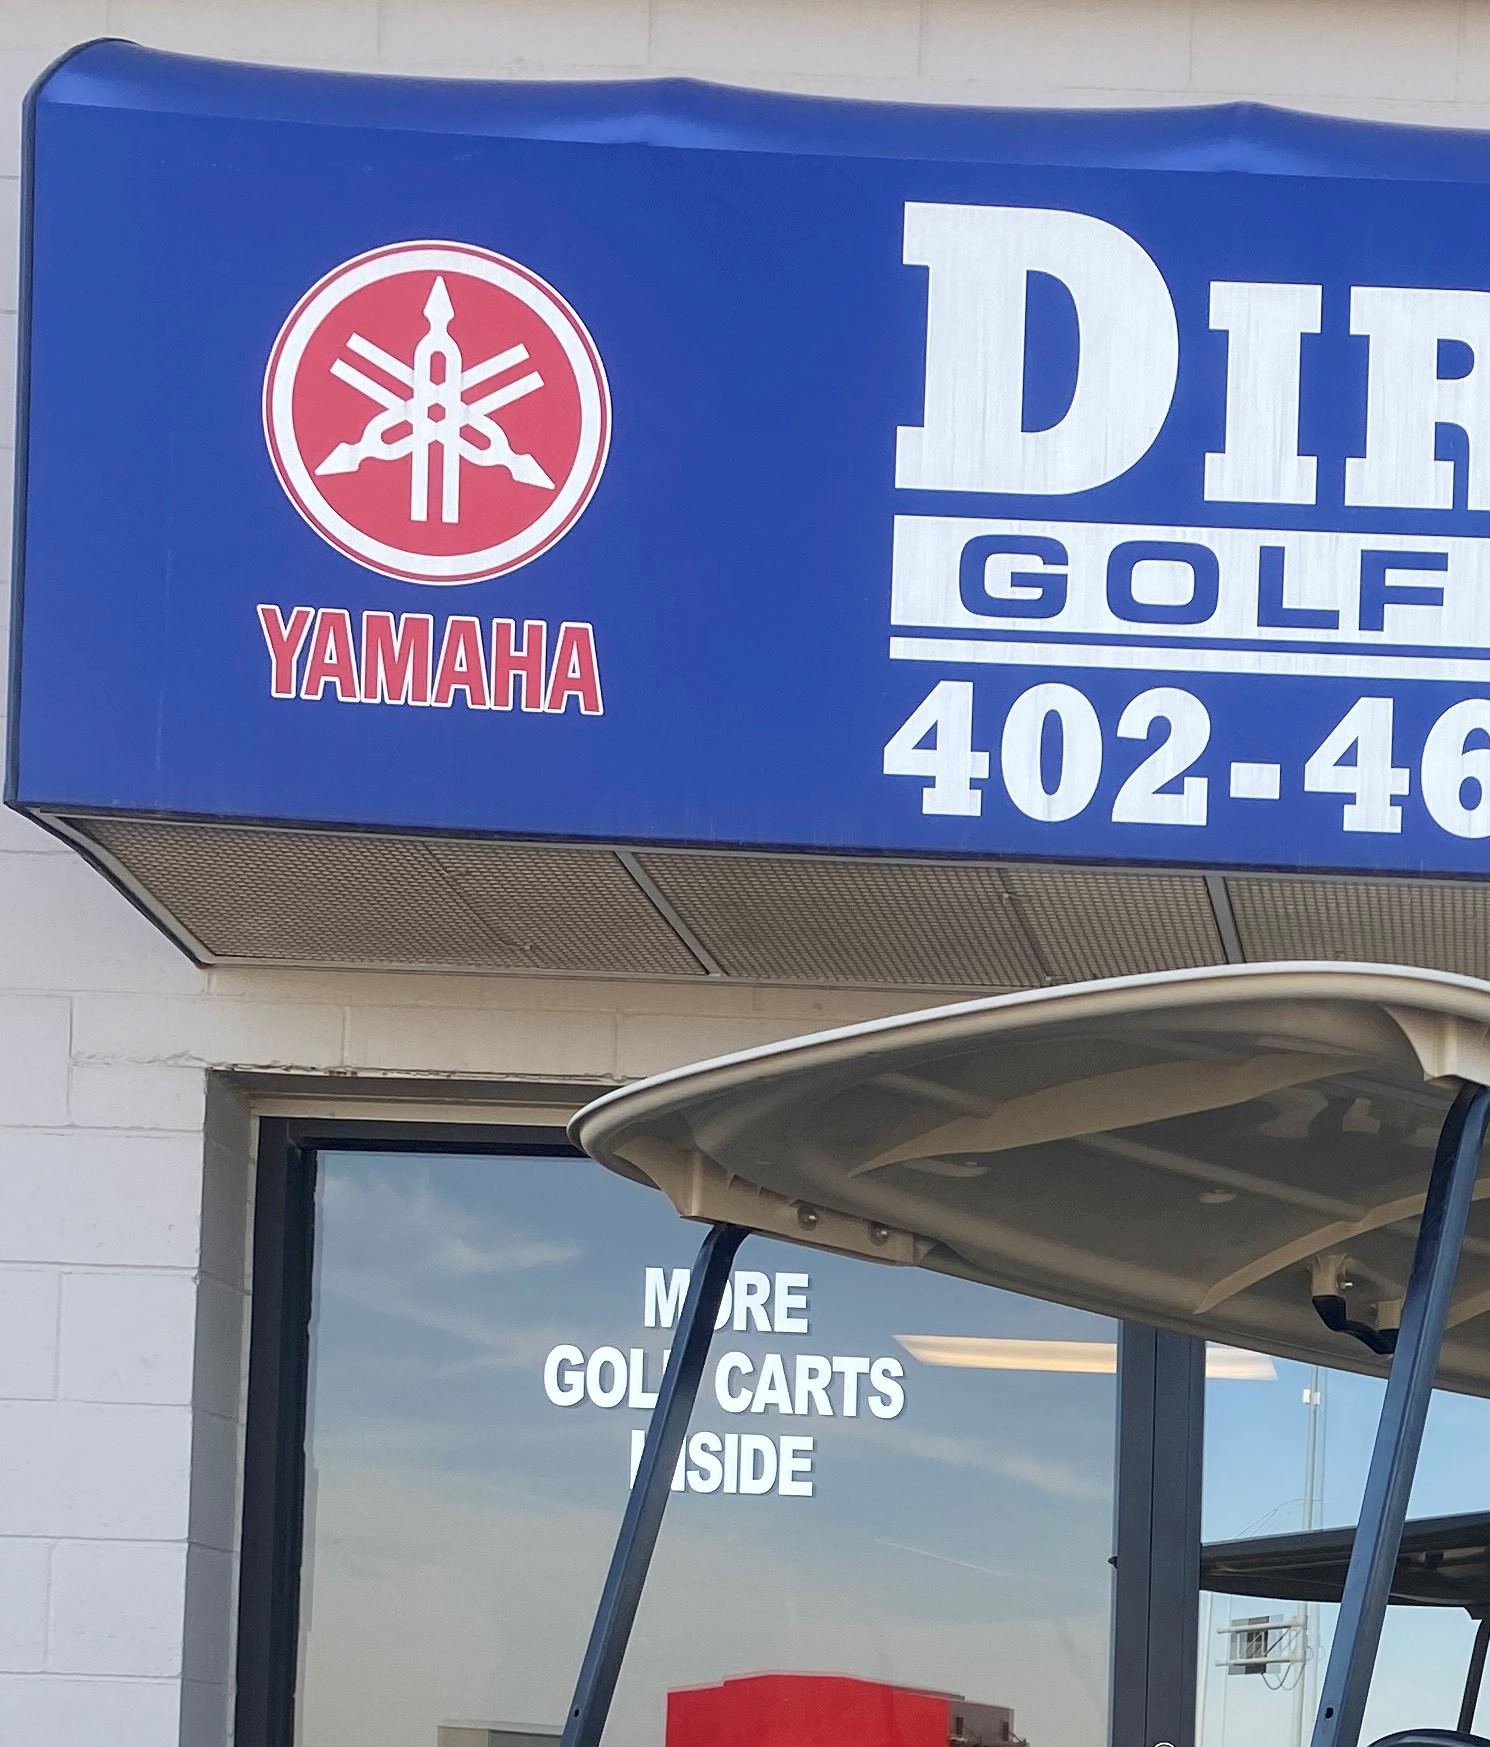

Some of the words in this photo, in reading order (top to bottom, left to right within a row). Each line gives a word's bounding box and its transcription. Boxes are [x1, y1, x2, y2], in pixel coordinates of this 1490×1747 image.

[959, 534, 1449, 632] GOLF
[256, 604, 604, 715] YAMAHA
[644, 1267, 809, 1334] MRE
[544, 1344, 672, 1408] GOL
[715, 1351, 904, 1419] CARTS
[630, 1430, 814, 1496] ISIDE
